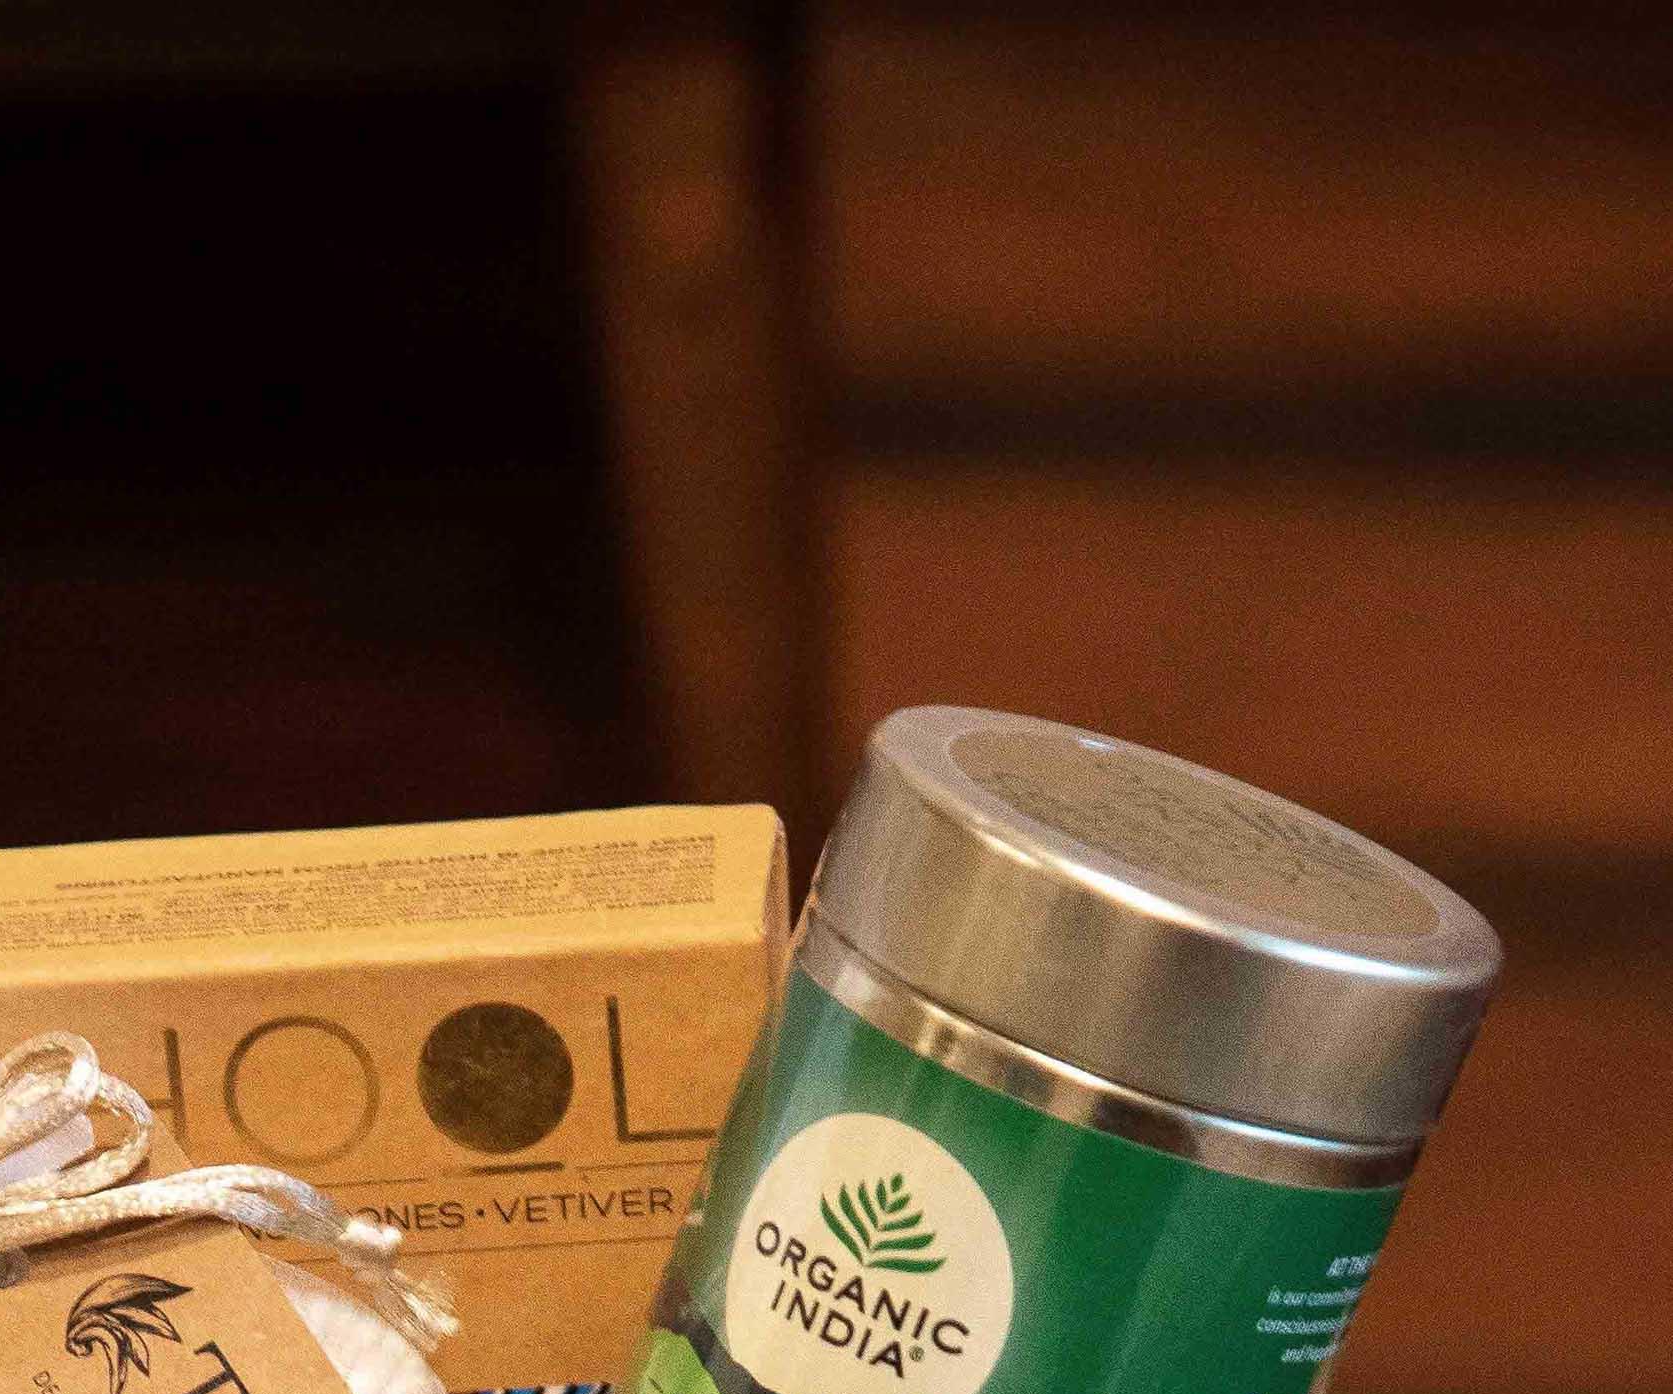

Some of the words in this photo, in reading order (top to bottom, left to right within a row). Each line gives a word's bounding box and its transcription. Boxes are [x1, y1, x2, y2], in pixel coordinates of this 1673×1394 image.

[347, 1201, 465, 1233] ONES
[492, 1187, 674, 1224] VETIVER
[755, 1221, 972, 1356] ORGANIC
